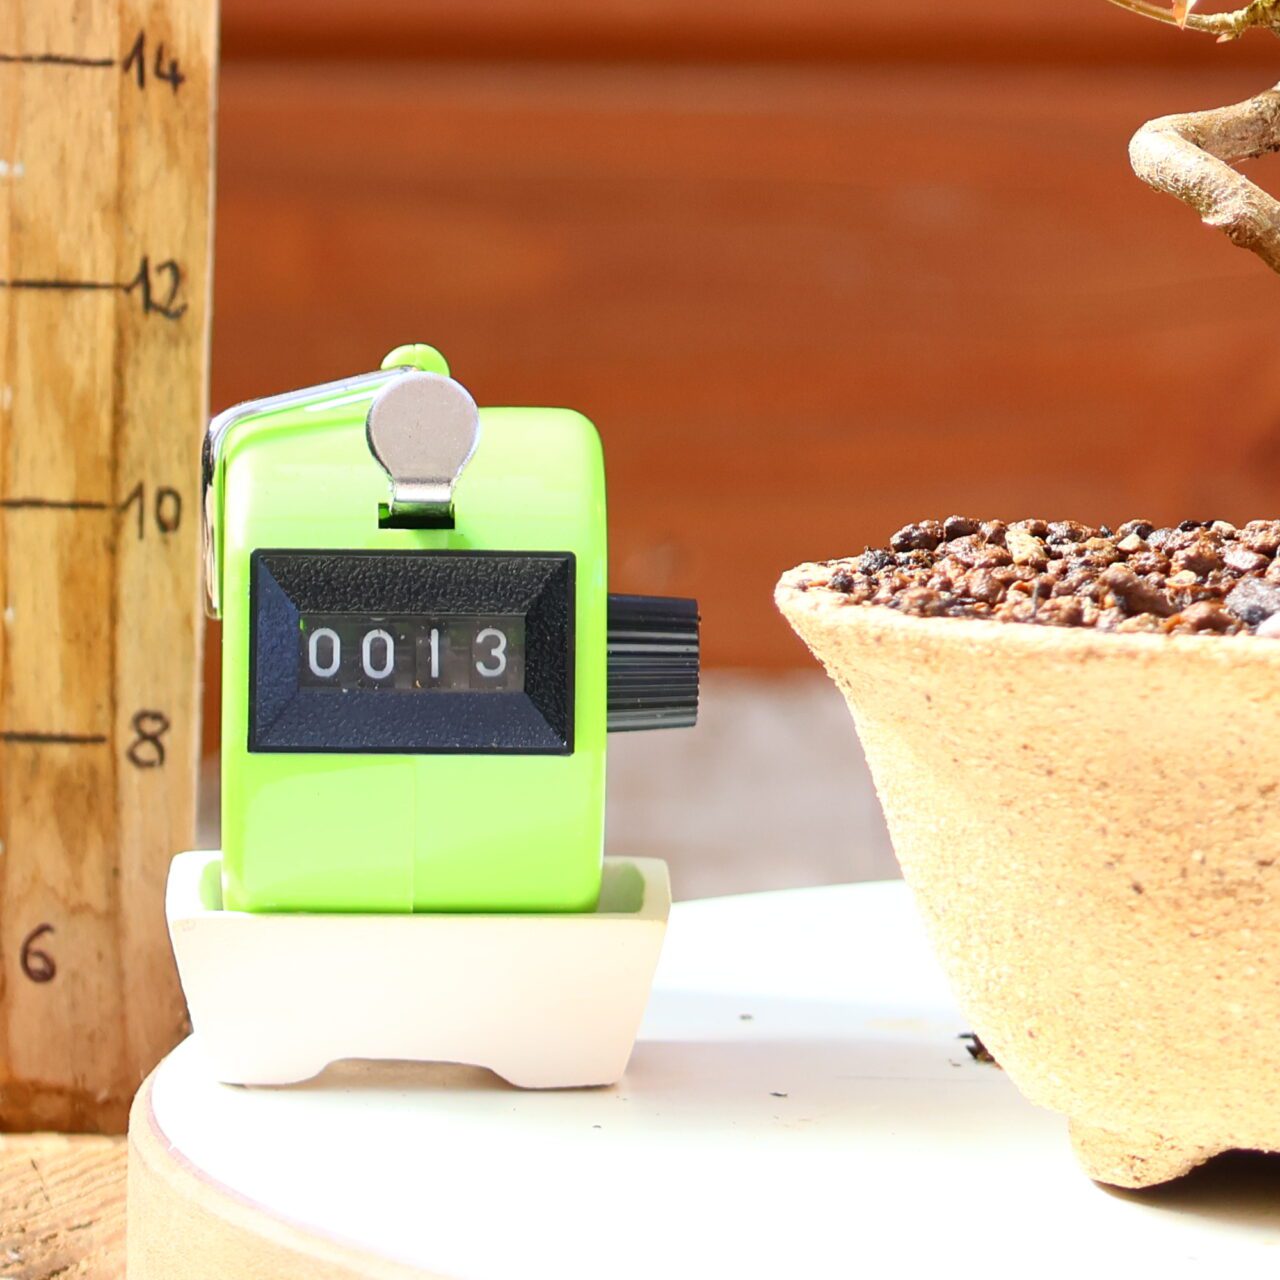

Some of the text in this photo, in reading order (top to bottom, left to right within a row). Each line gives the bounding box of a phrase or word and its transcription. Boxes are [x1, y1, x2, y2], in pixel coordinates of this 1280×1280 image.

[123, 29, 186, 95] 14
[123, 255, 188, 320] 12
[118, 480, 182, 540] 10
[308, 627, 507, 679] 0013
[126, 710, 170, 770] 8
[20, 923, 57, 983] 6
